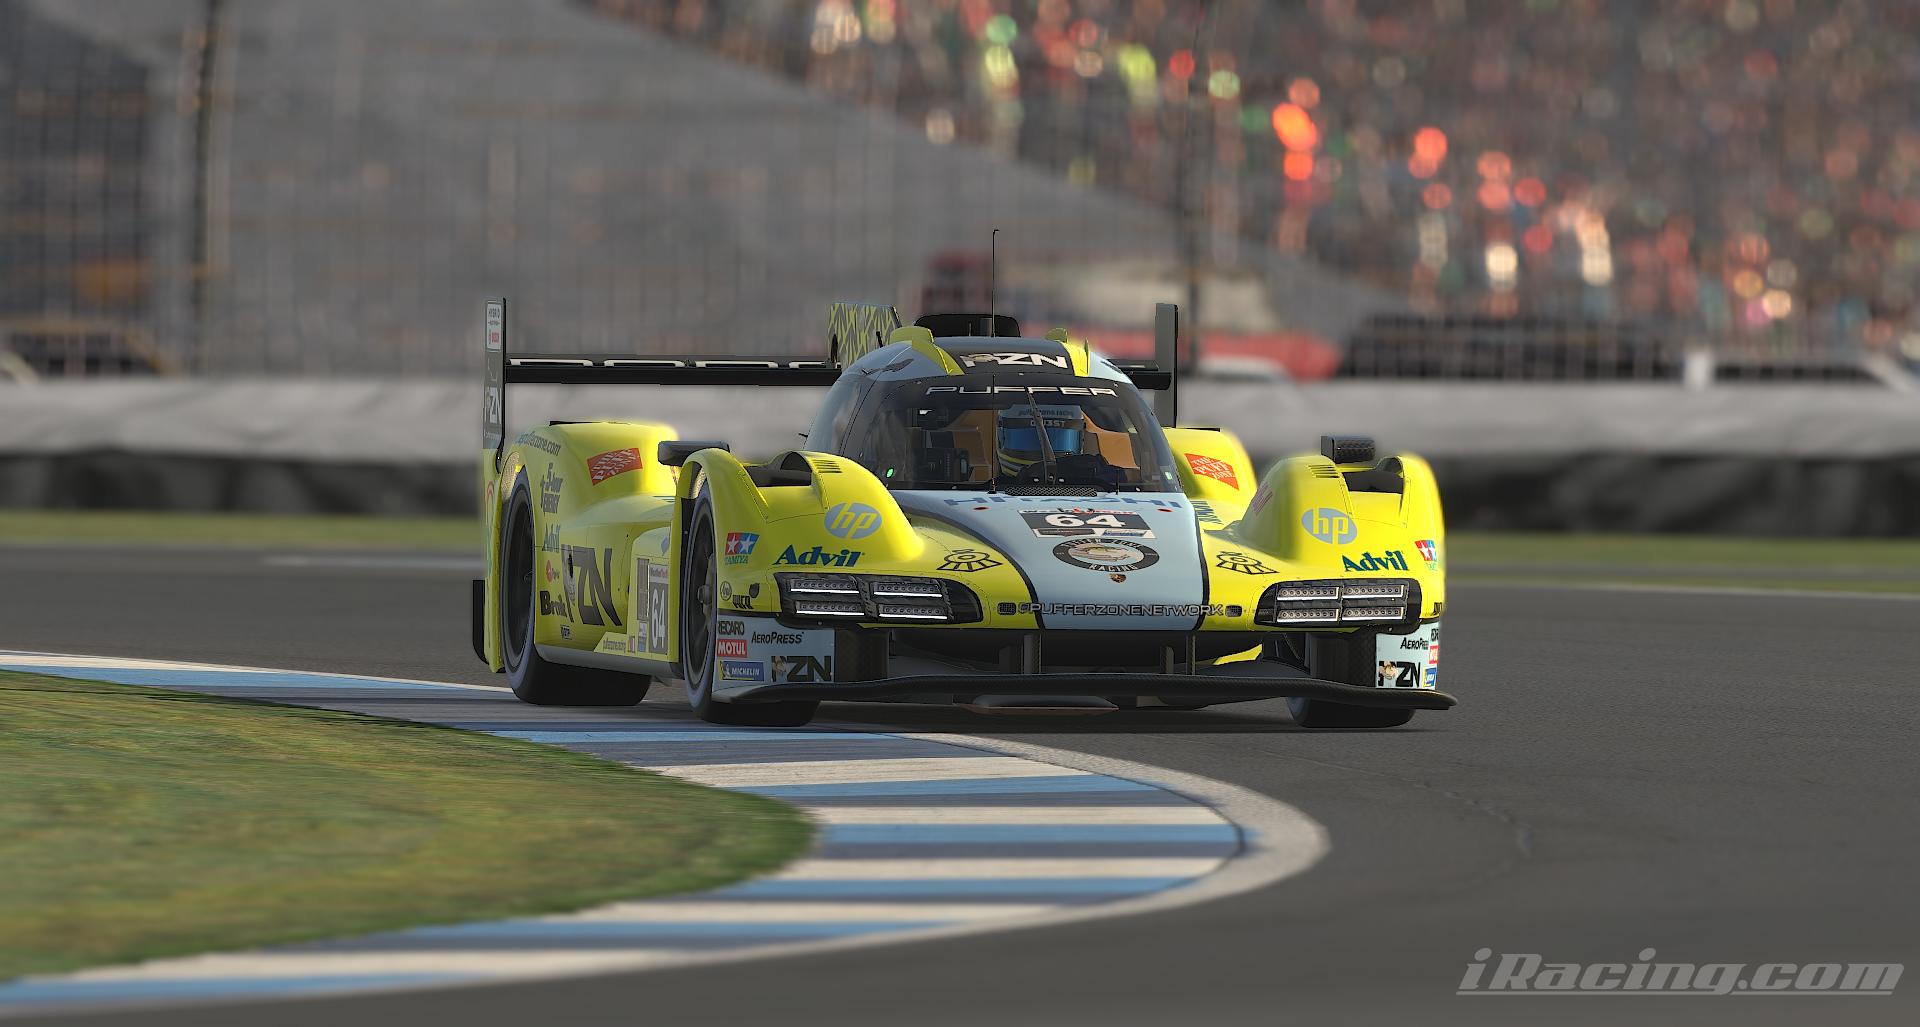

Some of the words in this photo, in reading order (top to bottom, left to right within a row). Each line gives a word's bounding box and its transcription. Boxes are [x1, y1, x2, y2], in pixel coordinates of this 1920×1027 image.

[925, 386, 1118, 397] PUFFER
[831, 503, 878, 538] hp
[1044, 514, 1126, 527] 64
[1312, 507, 1349, 544] hp
[771, 544, 861, 567] Advil
[1341, 550, 1410, 573] Advil
[651, 588, 666, 649] 64
[718, 641, 746, 655] MOTUL
[731, 667, 760, 676] MICHELIN
